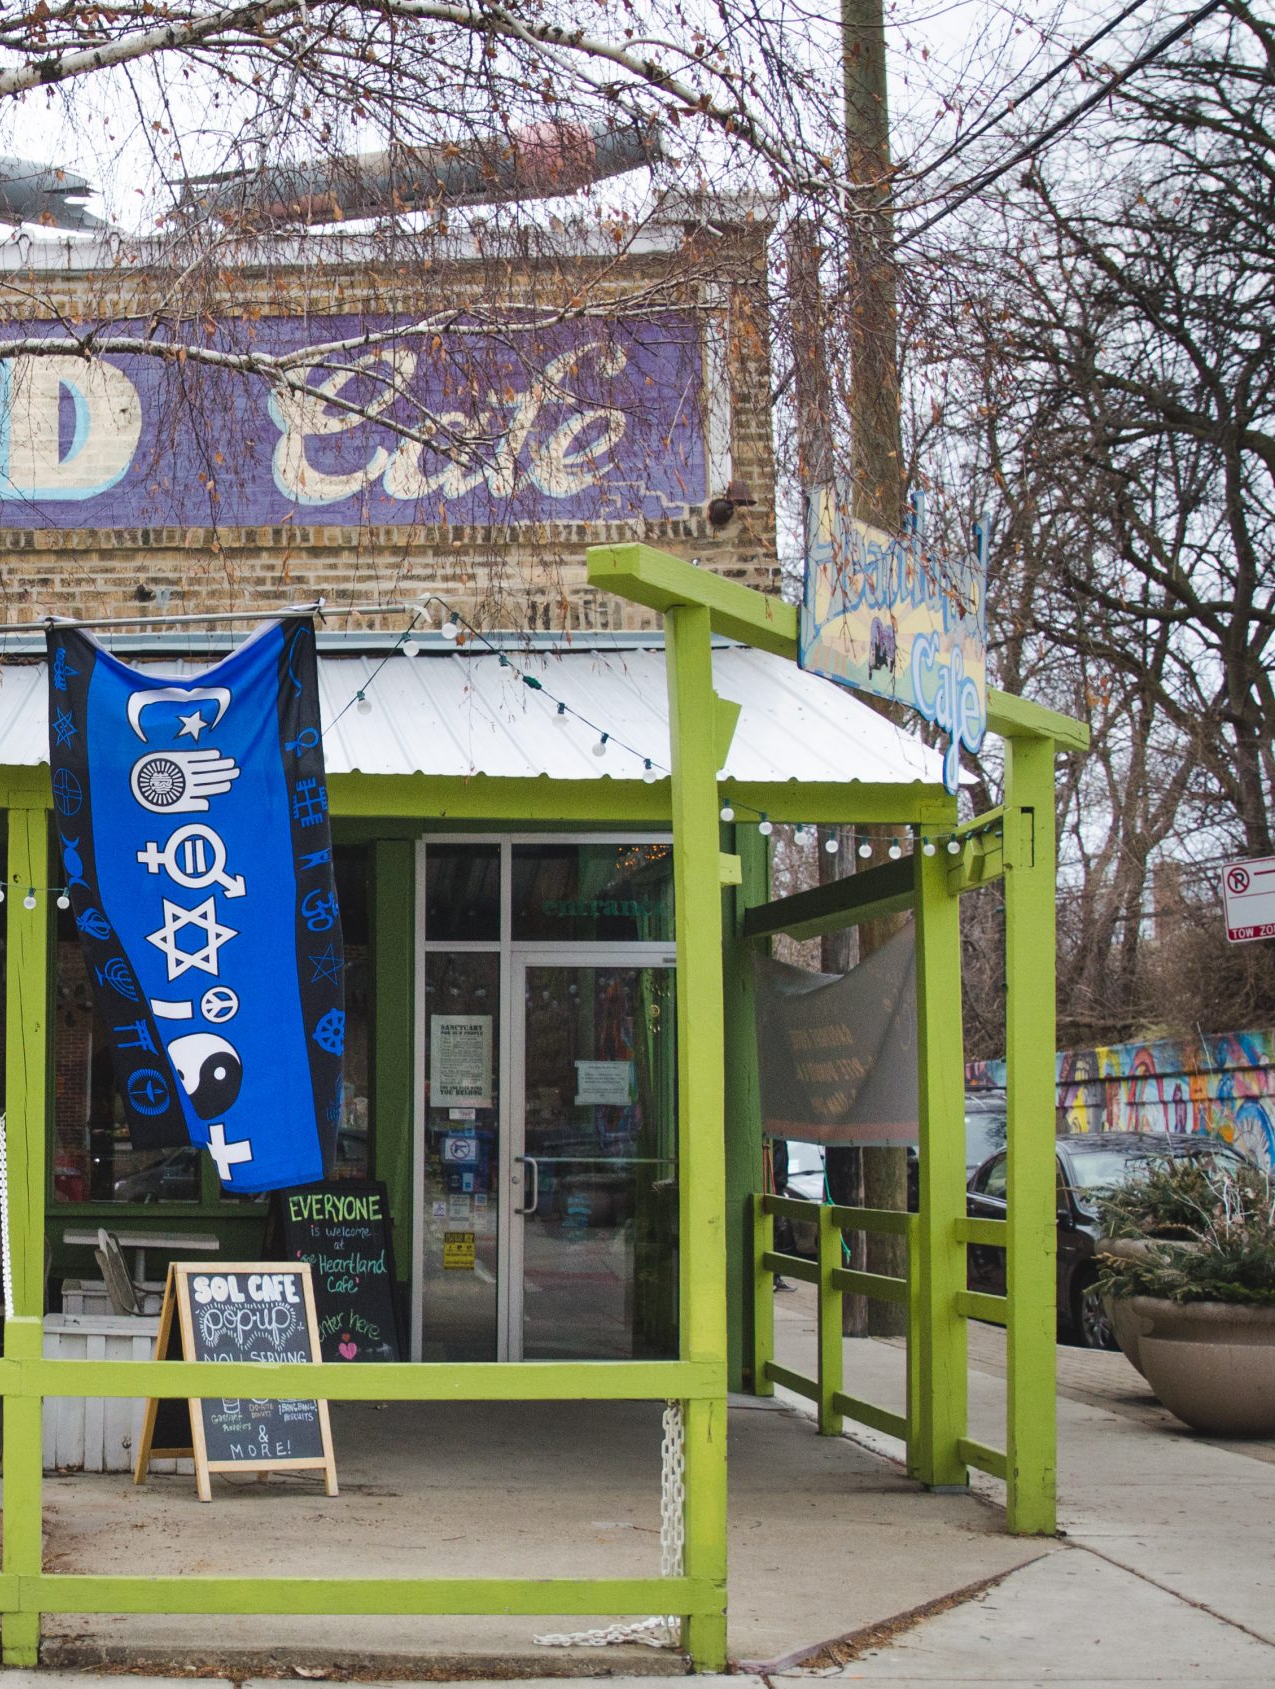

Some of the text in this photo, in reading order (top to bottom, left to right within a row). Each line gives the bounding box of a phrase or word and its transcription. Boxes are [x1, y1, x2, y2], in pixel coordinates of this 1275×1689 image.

[267, 341, 628, 504] Cafe
[910, 631, 987, 796] Cafe
[1232, 928, 1253, 939] TOW
[289, 1194, 383, 1222] EVERYONE
[310, 1225, 372, 1239] is welcome
[333, 1240, 345, 1250] at
[319, 1249, 388, 1275] Heartland
[193, 1274, 300, 1304] SOL CAFE
[319, 1308, 381, 1342] nter here
[258, 1425, 269, 1443] &
[230, 1440, 292, 1460] MORE!
